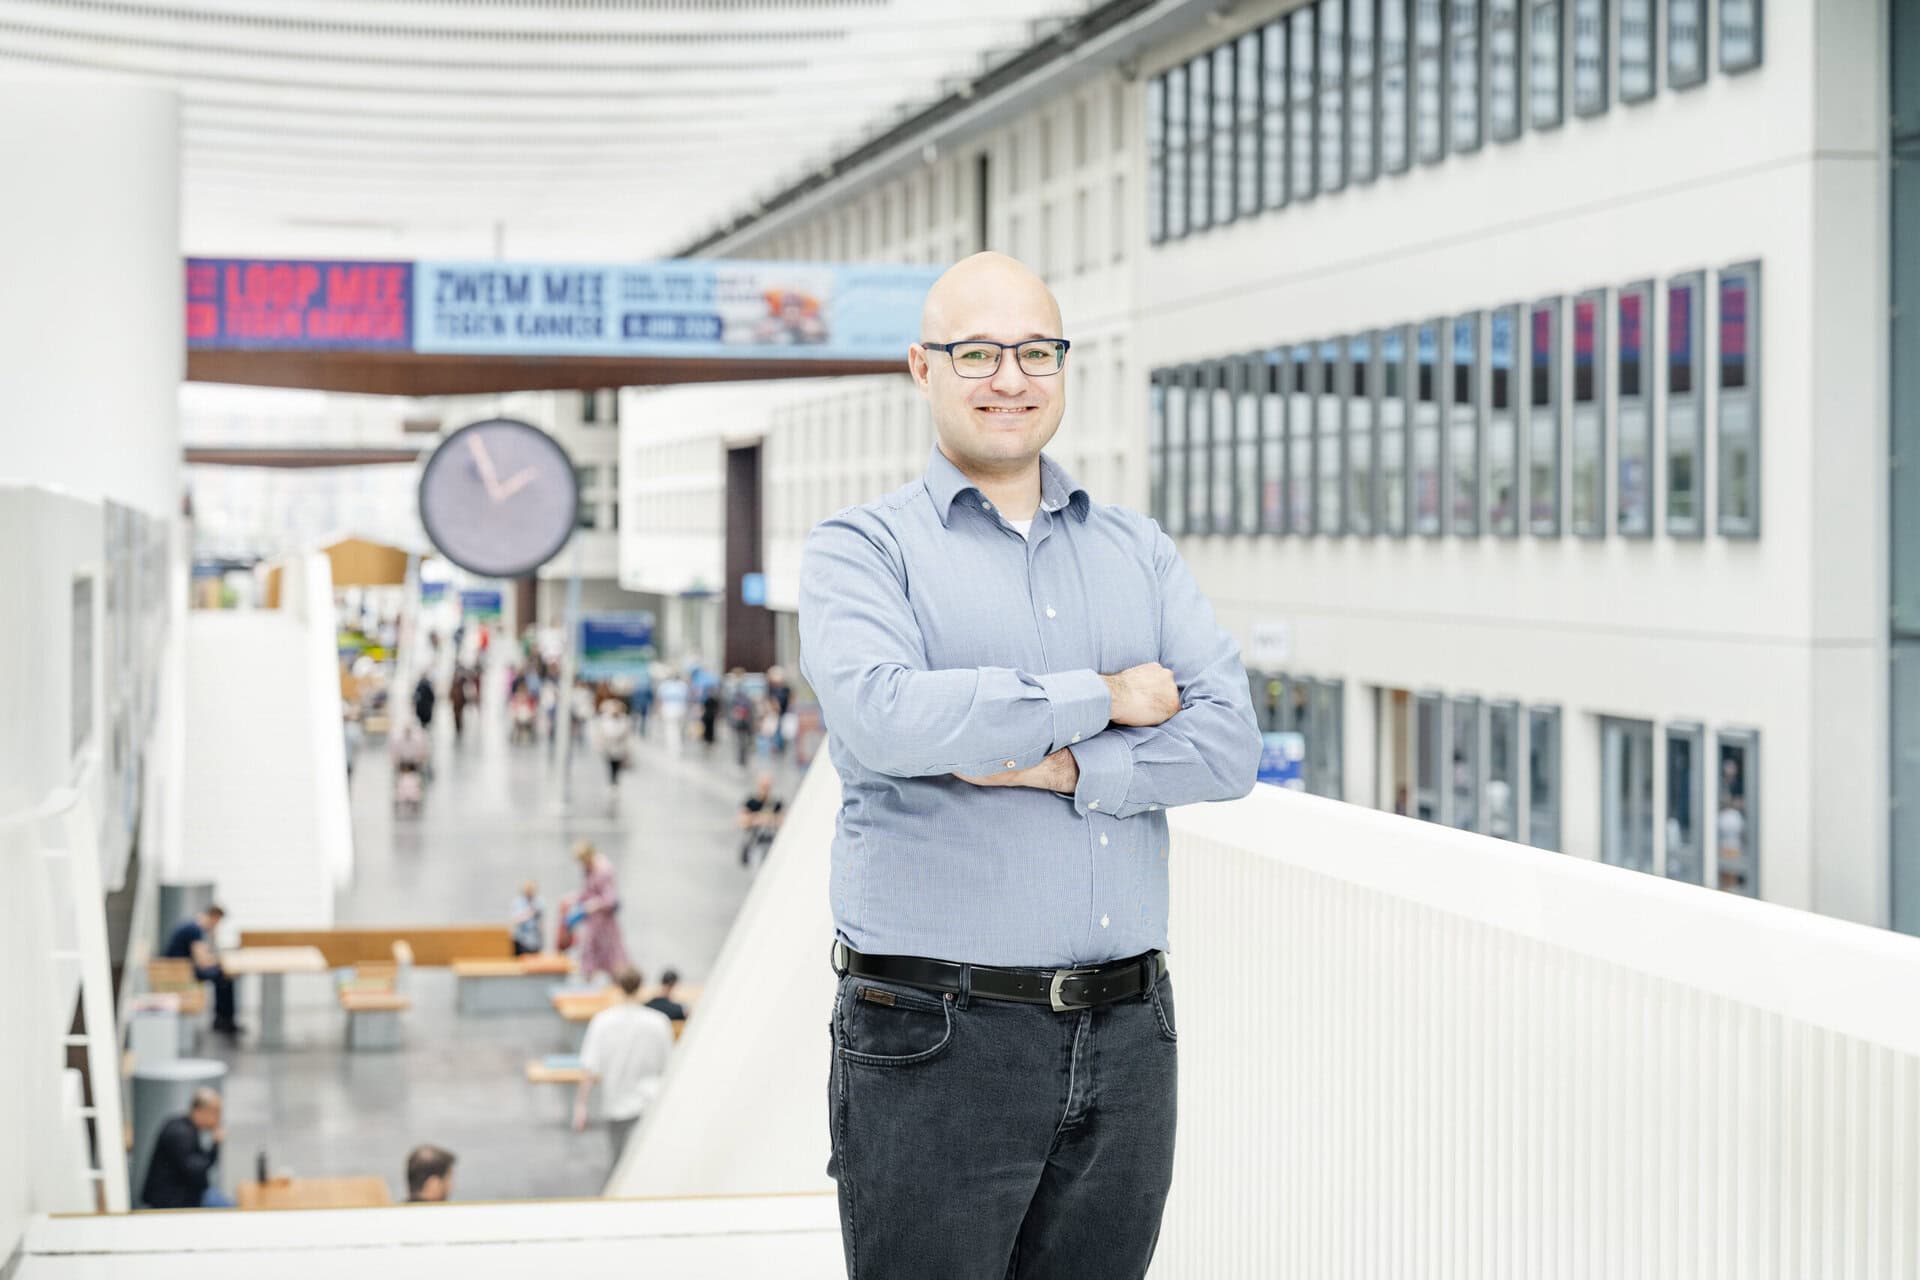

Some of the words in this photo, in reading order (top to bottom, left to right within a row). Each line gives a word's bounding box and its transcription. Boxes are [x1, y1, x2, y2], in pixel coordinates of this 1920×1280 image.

[225, 263, 320, 304] LOOP
[327, 265, 405, 305] MEE
[436, 270, 529, 304] ZWEM
[544, 272, 603, 306] MEE
